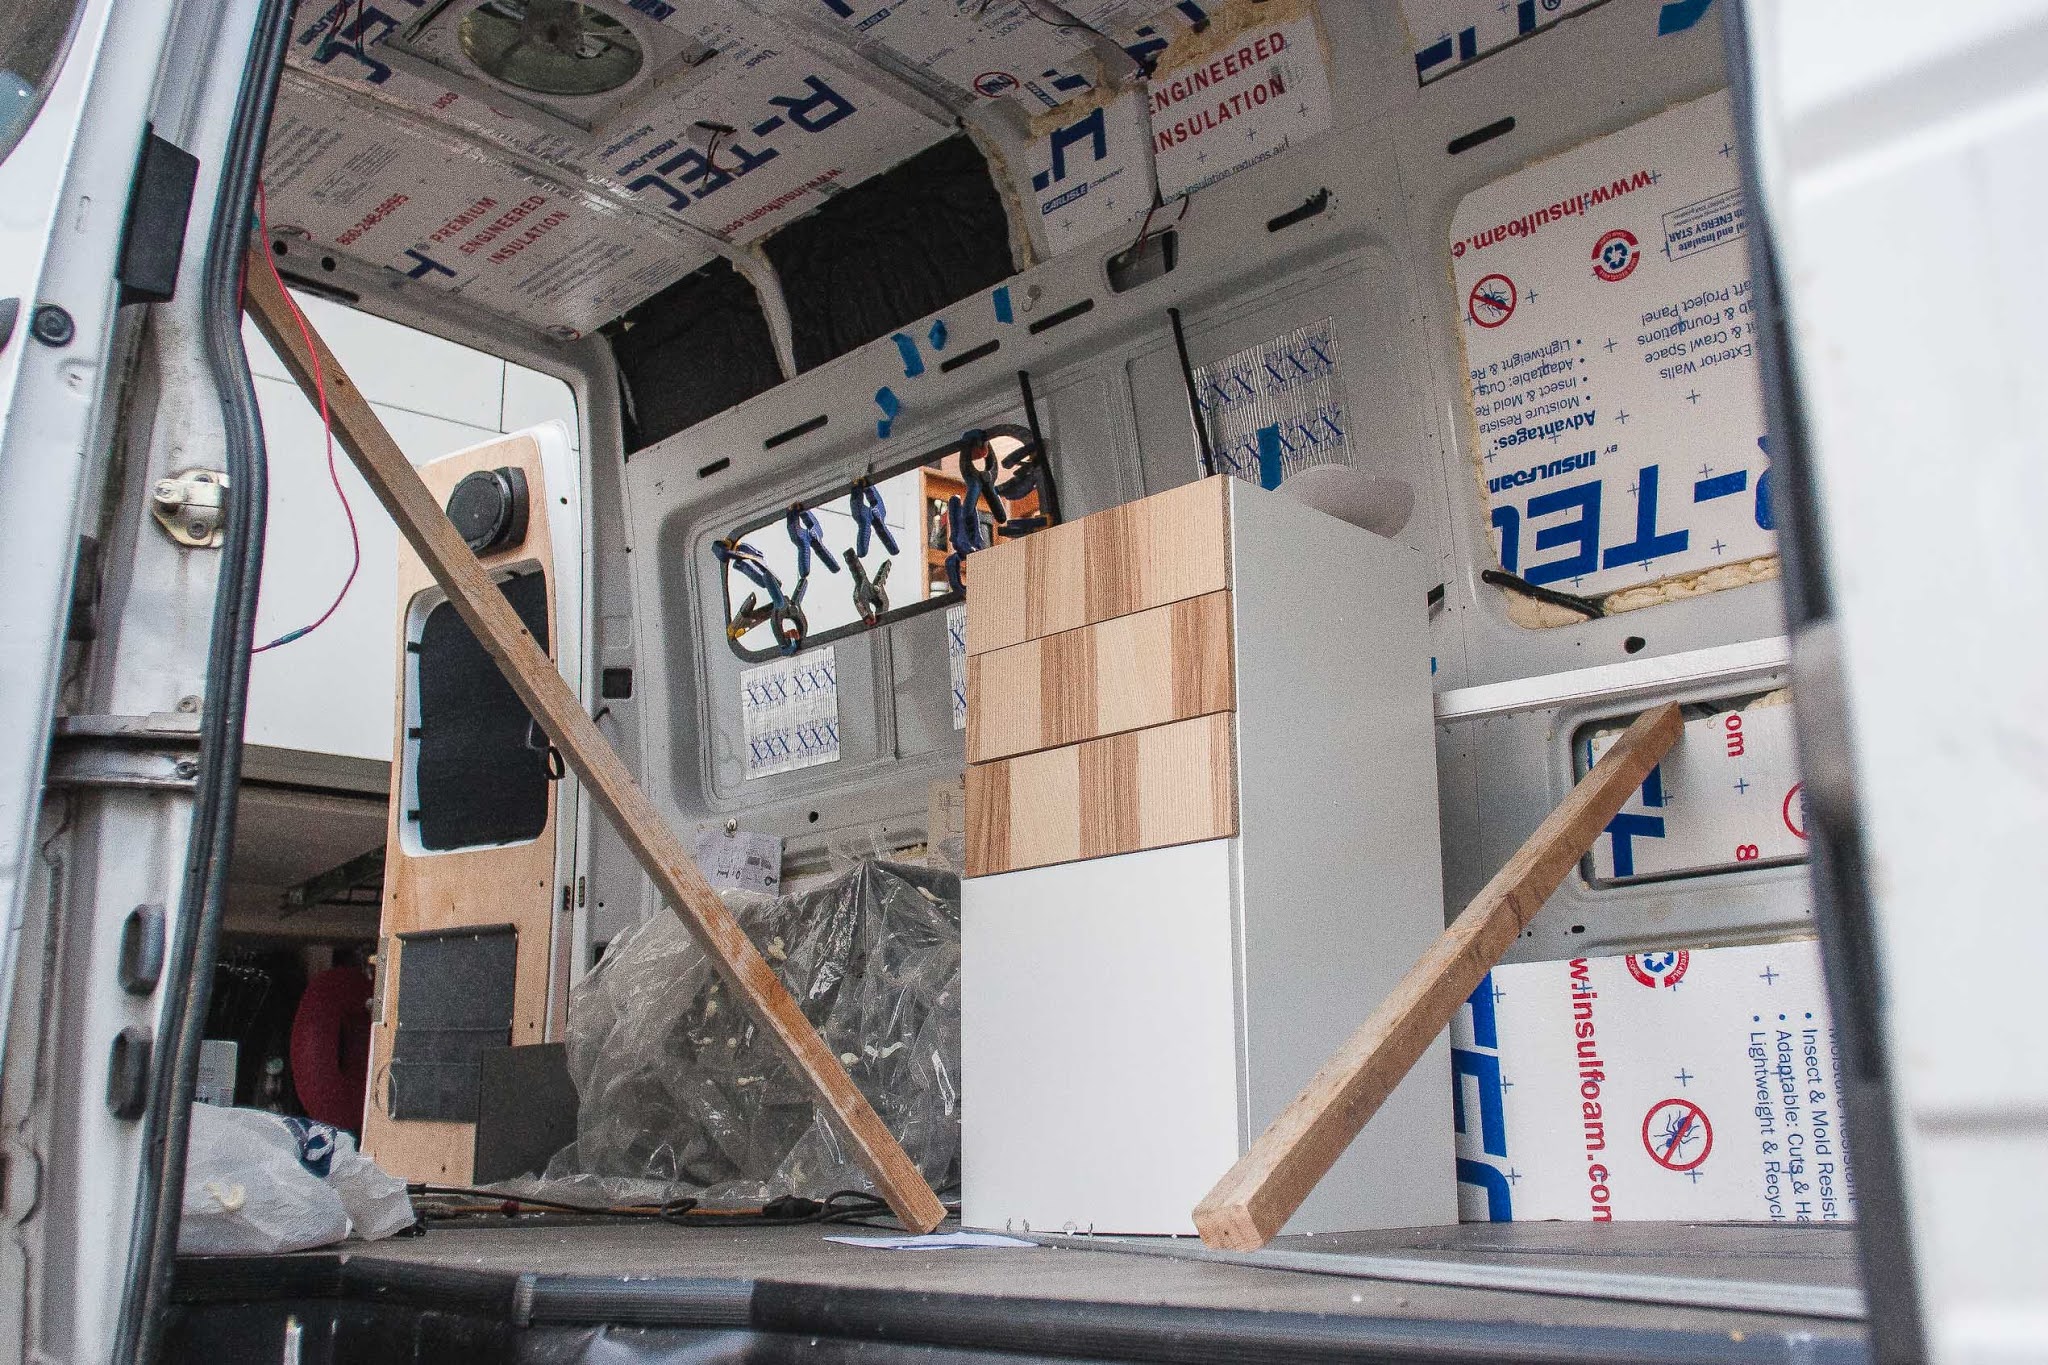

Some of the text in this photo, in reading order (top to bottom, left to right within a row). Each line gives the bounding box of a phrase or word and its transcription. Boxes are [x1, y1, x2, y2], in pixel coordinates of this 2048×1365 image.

[1154, 73, 1286, 156] INSULATION
[1042, 183, 1088, 214] CARLISLE
[429, 197, 499, 244] PREMIUM
[460, 194, 546, 256] ENGINEERED
[488, 210, 570, 265] INSULATION
[1678, 231, 1717, 252] Insulate
[1684, 287, 1730, 309] Project
[1724, 306, 1736, 321] &
[1637, 312, 1721, 346] Foundations
[1641, 303, 1680, 327] Panel
[1690, 331, 1728, 350] Crawl
[1730, 326, 1743, 340] &
[1501, 338, 1572, 371] Lightweight
[1644, 343, 1687, 364] Space
[1659, 343, 1753, 381] Exterior Walls
[1509, 357, 1574, 391] Adaptable:
[1540, 376, 1578, 398] Insect
[1494, 391, 1523, 409] Mold
[1525, 387, 1538, 400] &
[1526, 394, 1581, 420] Moisture
[1493, 410, 1597, 451] Advantages:
[1603, 443, 1618, 455] BY
[1802, 1028, 1821, 1084] Insect
[1748, 1032, 1775, 1135] Lightweight
[1762, 1141, 1778, 1154] &
[1776, 1030, 1800, 1127] Adaptable:
[1809, 1089, 1826, 1103] &
[1812, 1110, 1832, 1155] Mold
[1788, 1133, 1804, 1175] Cuts
[1793, 1180, 1810, 1195] &
